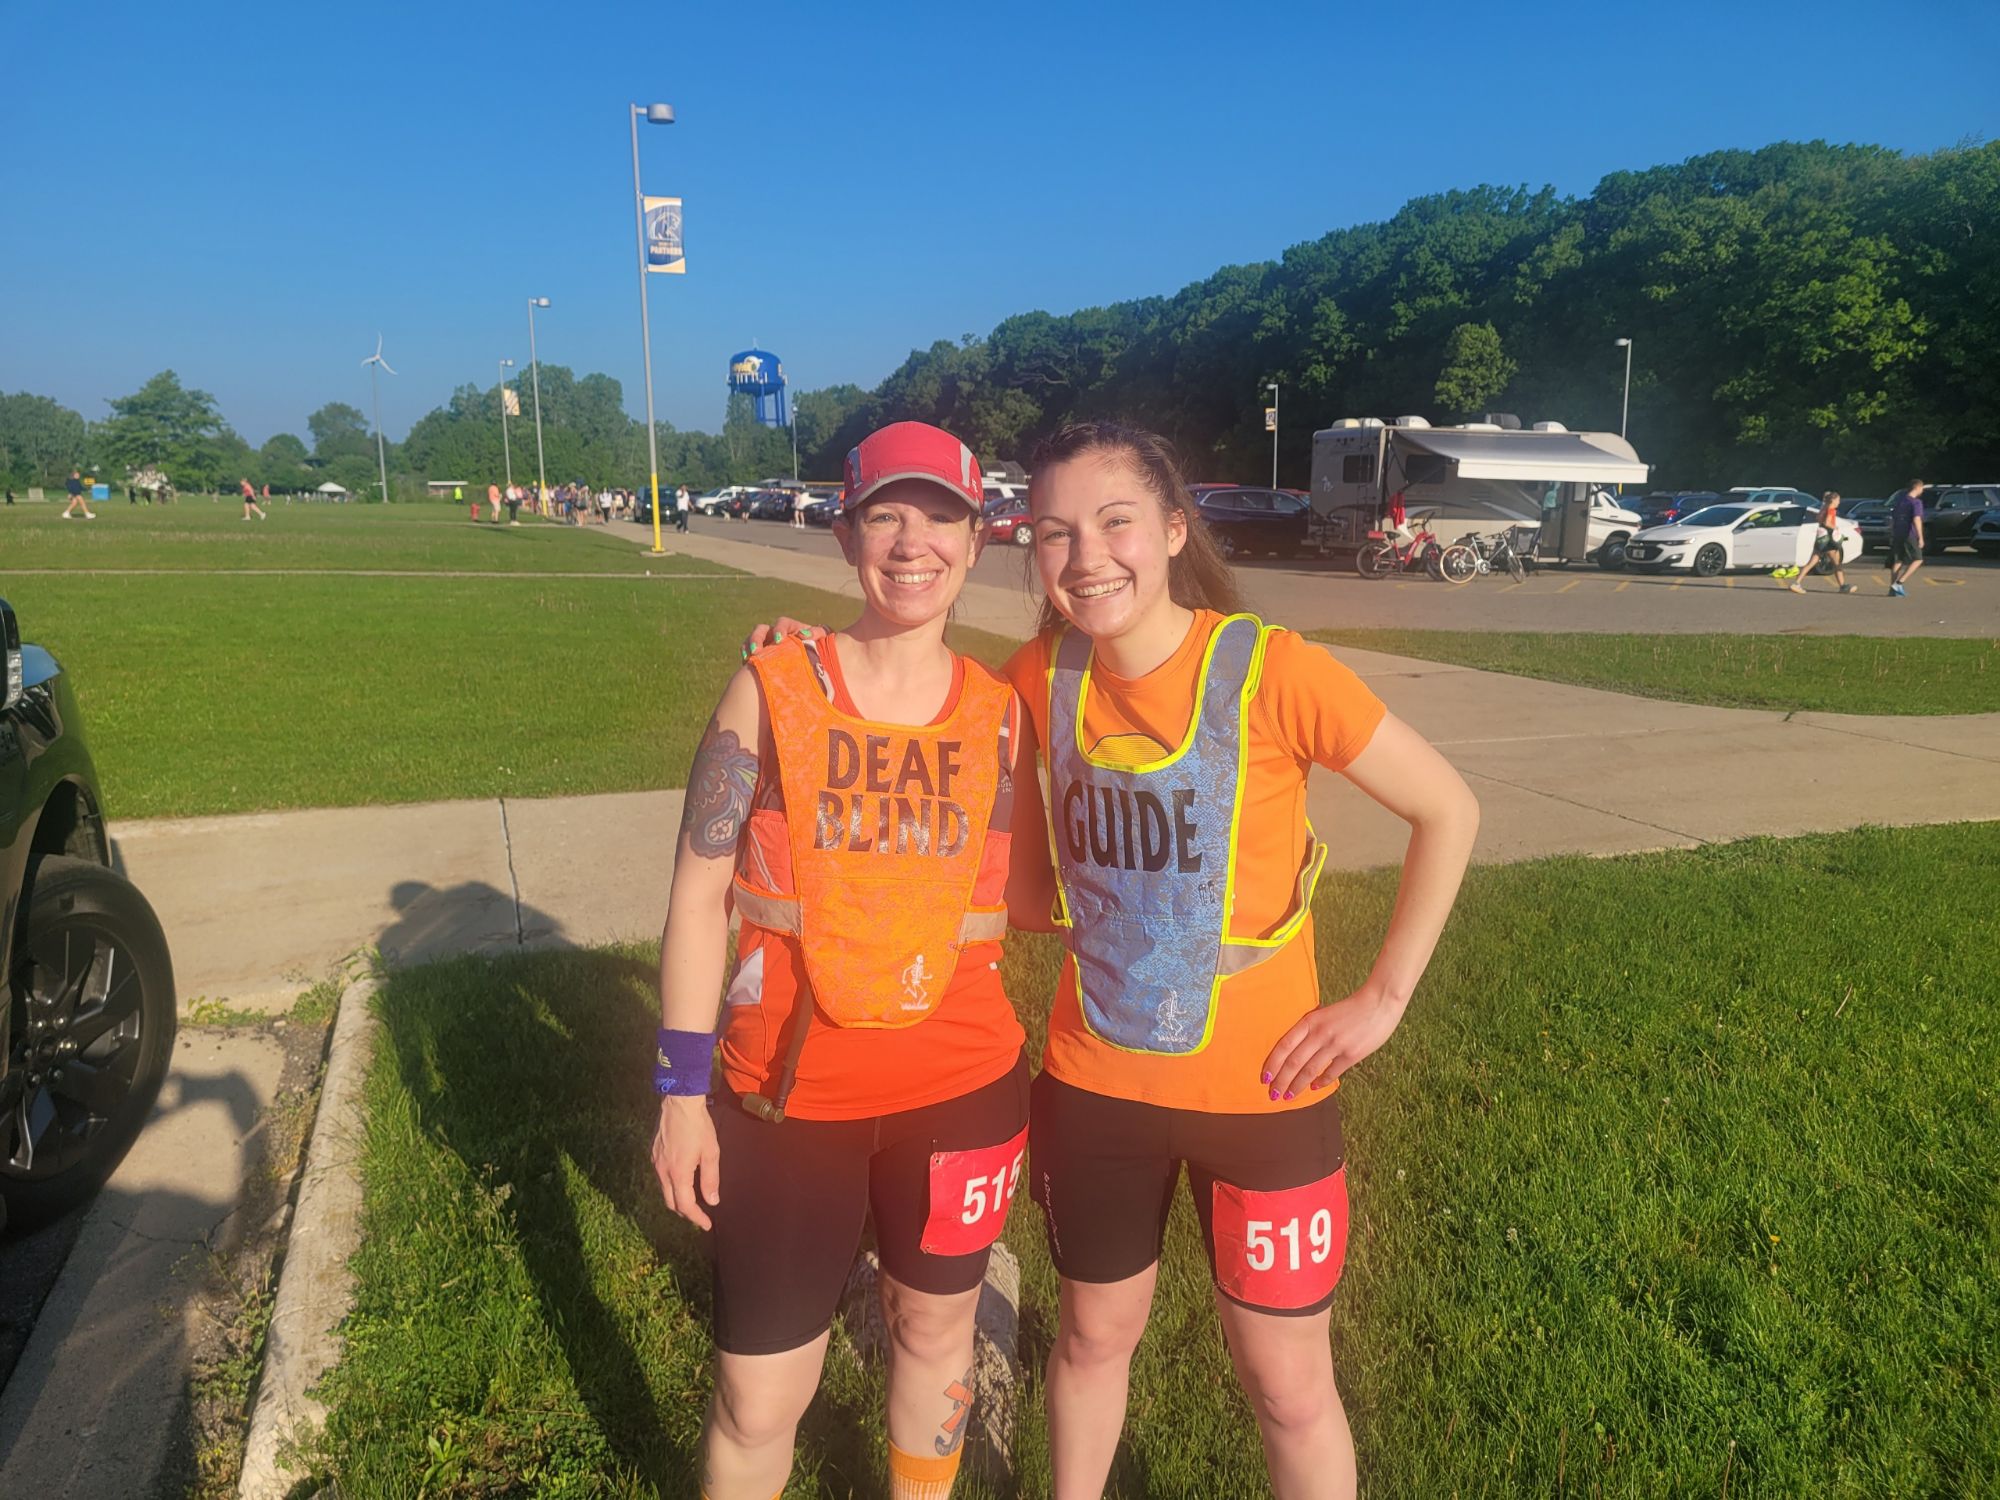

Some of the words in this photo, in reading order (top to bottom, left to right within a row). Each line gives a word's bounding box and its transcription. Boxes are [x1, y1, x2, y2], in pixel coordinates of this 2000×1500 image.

[827, 729, 962, 797] DEAF
[813, 791, 969, 857] BLIND
[1064, 780, 1202, 873] GUIDE
[962, 1148, 1024, 1224] 515
[1246, 1208, 1332, 1271] 519
